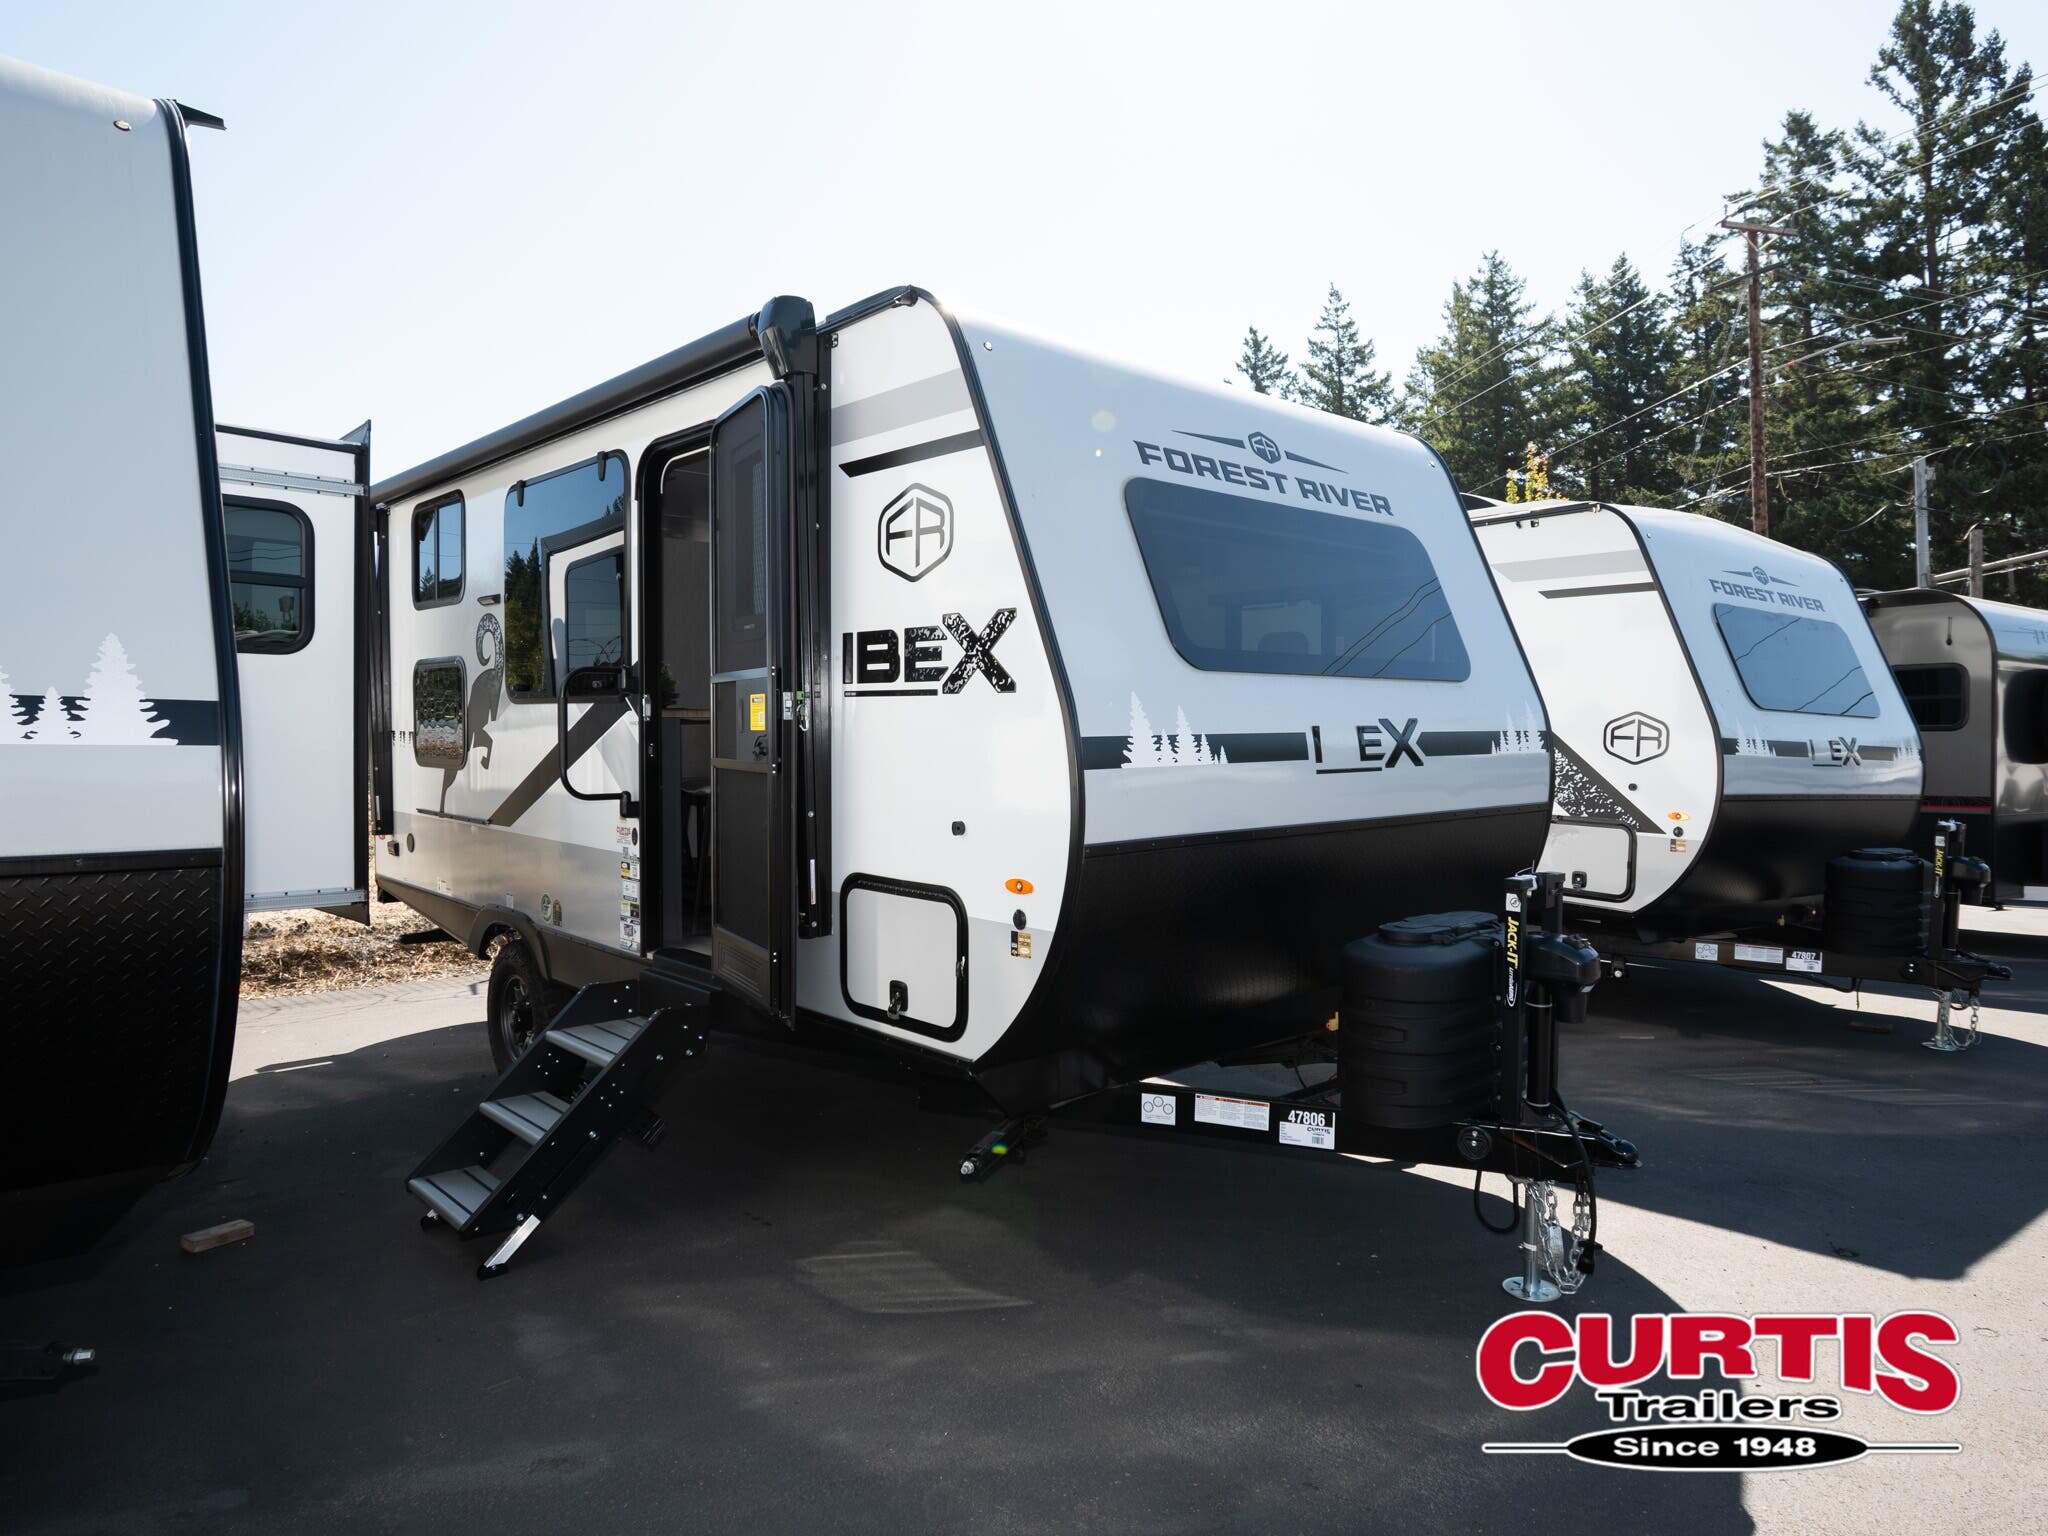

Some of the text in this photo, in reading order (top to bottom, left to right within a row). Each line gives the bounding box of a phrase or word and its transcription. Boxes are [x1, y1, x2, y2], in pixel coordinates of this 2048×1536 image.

[1133, 439, 1394, 516] FOREST RIVER
[1708, 578, 1826, 612] FOREST RIVER
[842, 607, 1017, 694] IBEX
[1507, 916, 1519, 969] JACK-IT
[1792, 951, 1816, 960] 47807
[1288, 1110, 1325, 1127] 47806
